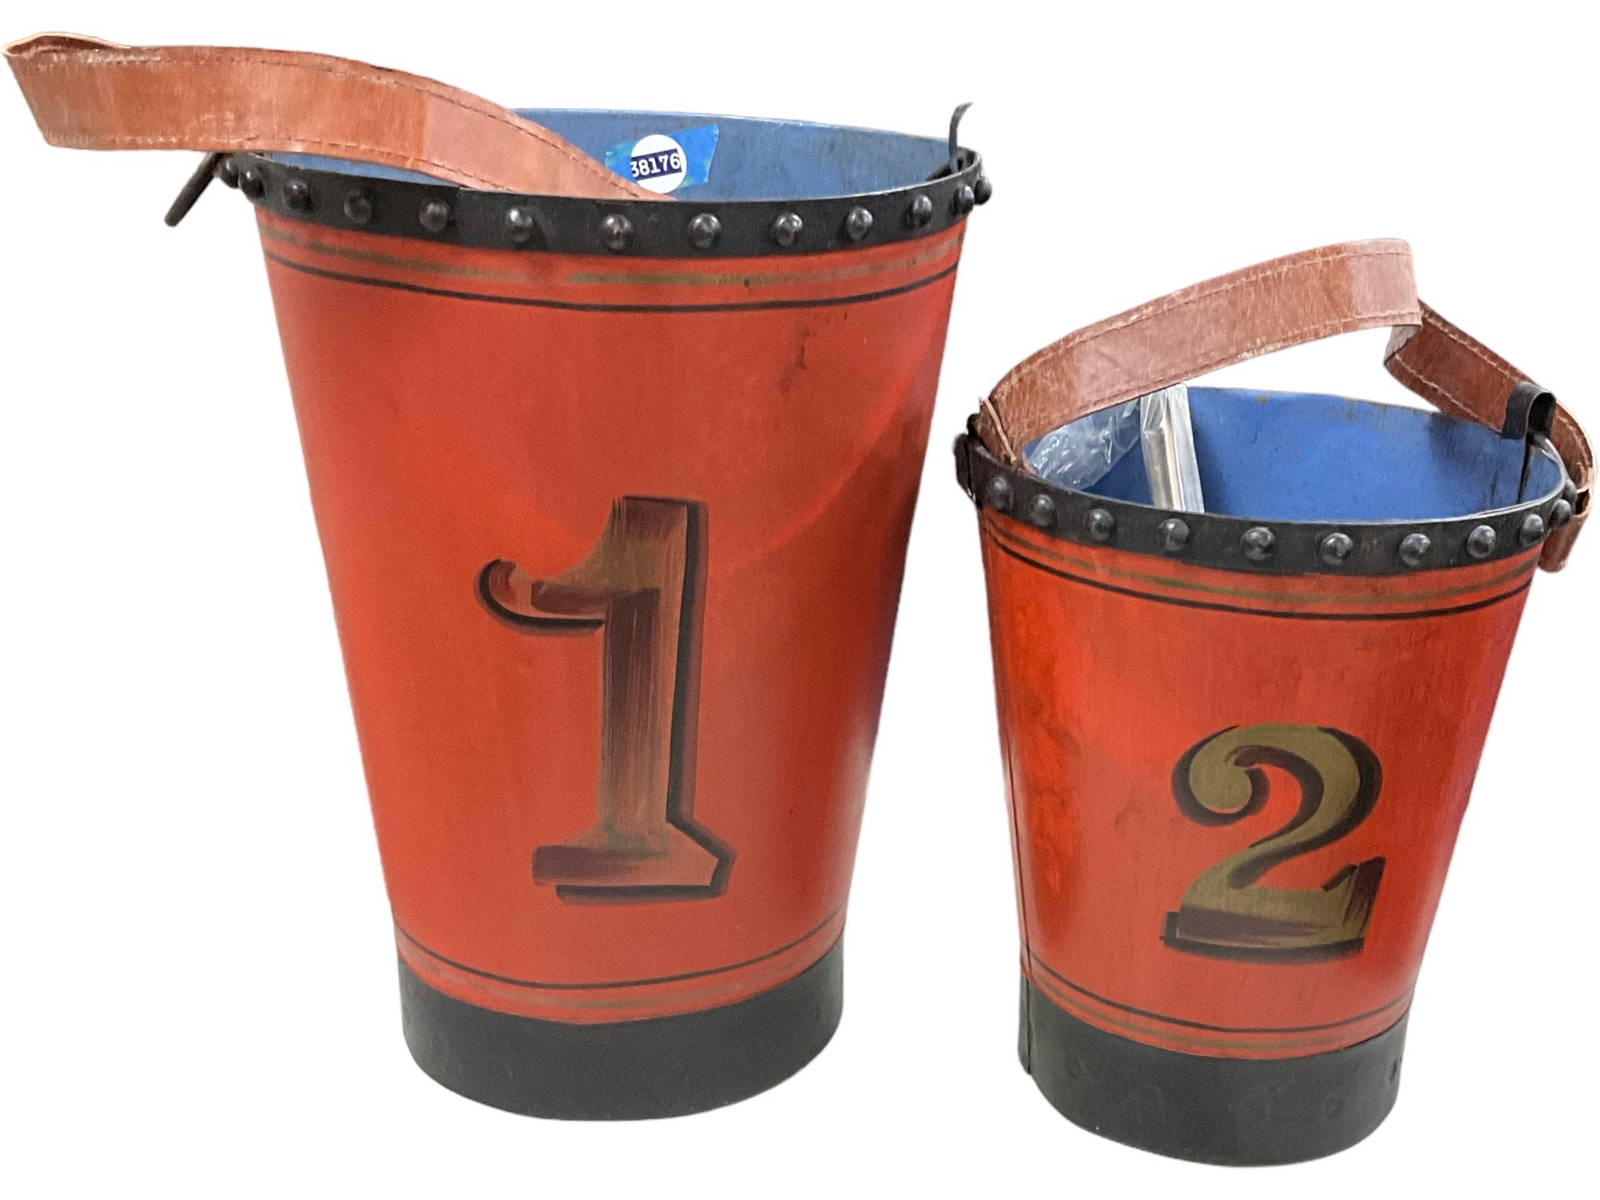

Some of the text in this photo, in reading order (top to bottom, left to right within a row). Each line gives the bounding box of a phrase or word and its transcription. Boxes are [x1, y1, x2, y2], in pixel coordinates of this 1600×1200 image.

[630, 153, 680, 177] 38176
[475, 496, 735, 904] 1
[1159, 722, 1386, 965] 2
